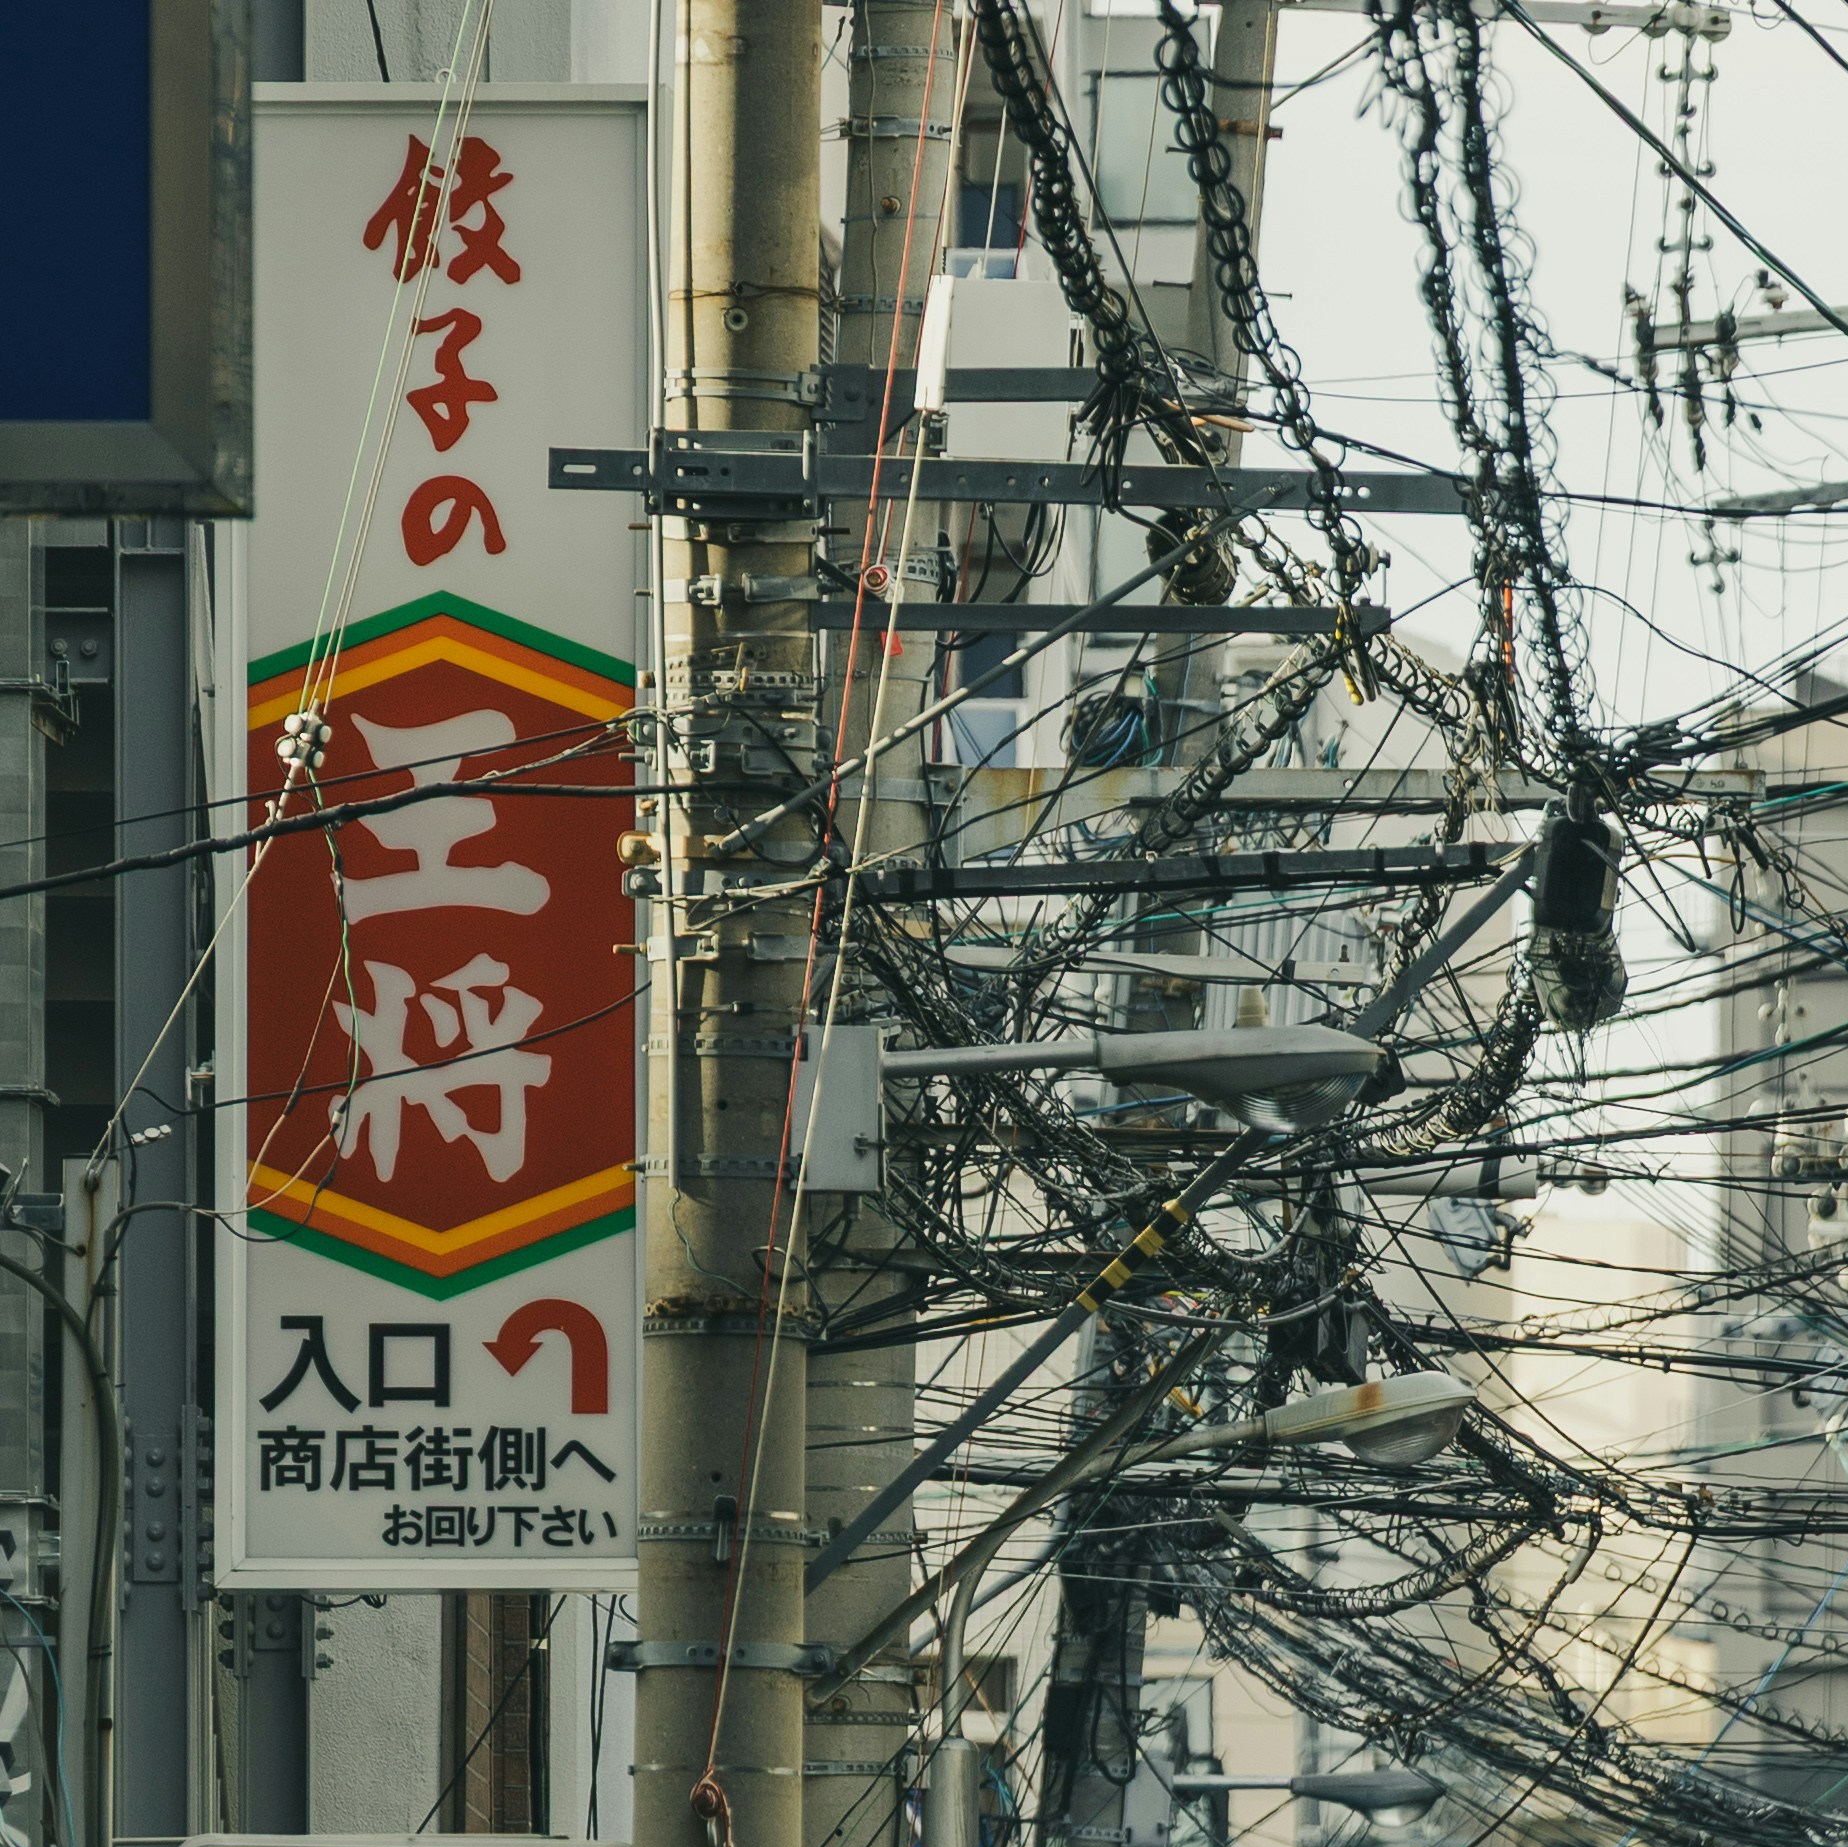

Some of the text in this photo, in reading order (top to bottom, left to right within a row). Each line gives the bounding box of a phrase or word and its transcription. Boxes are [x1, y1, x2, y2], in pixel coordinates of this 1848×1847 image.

[363, 134, 521, 567] 餃子の
[329, 708, 551, 1183] 王将
[258, 1315, 451, 1412] 入口
[257, 1426, 617, 1492] 商店街側へ
[381, 1503, 617, 1549] お回り下さい
